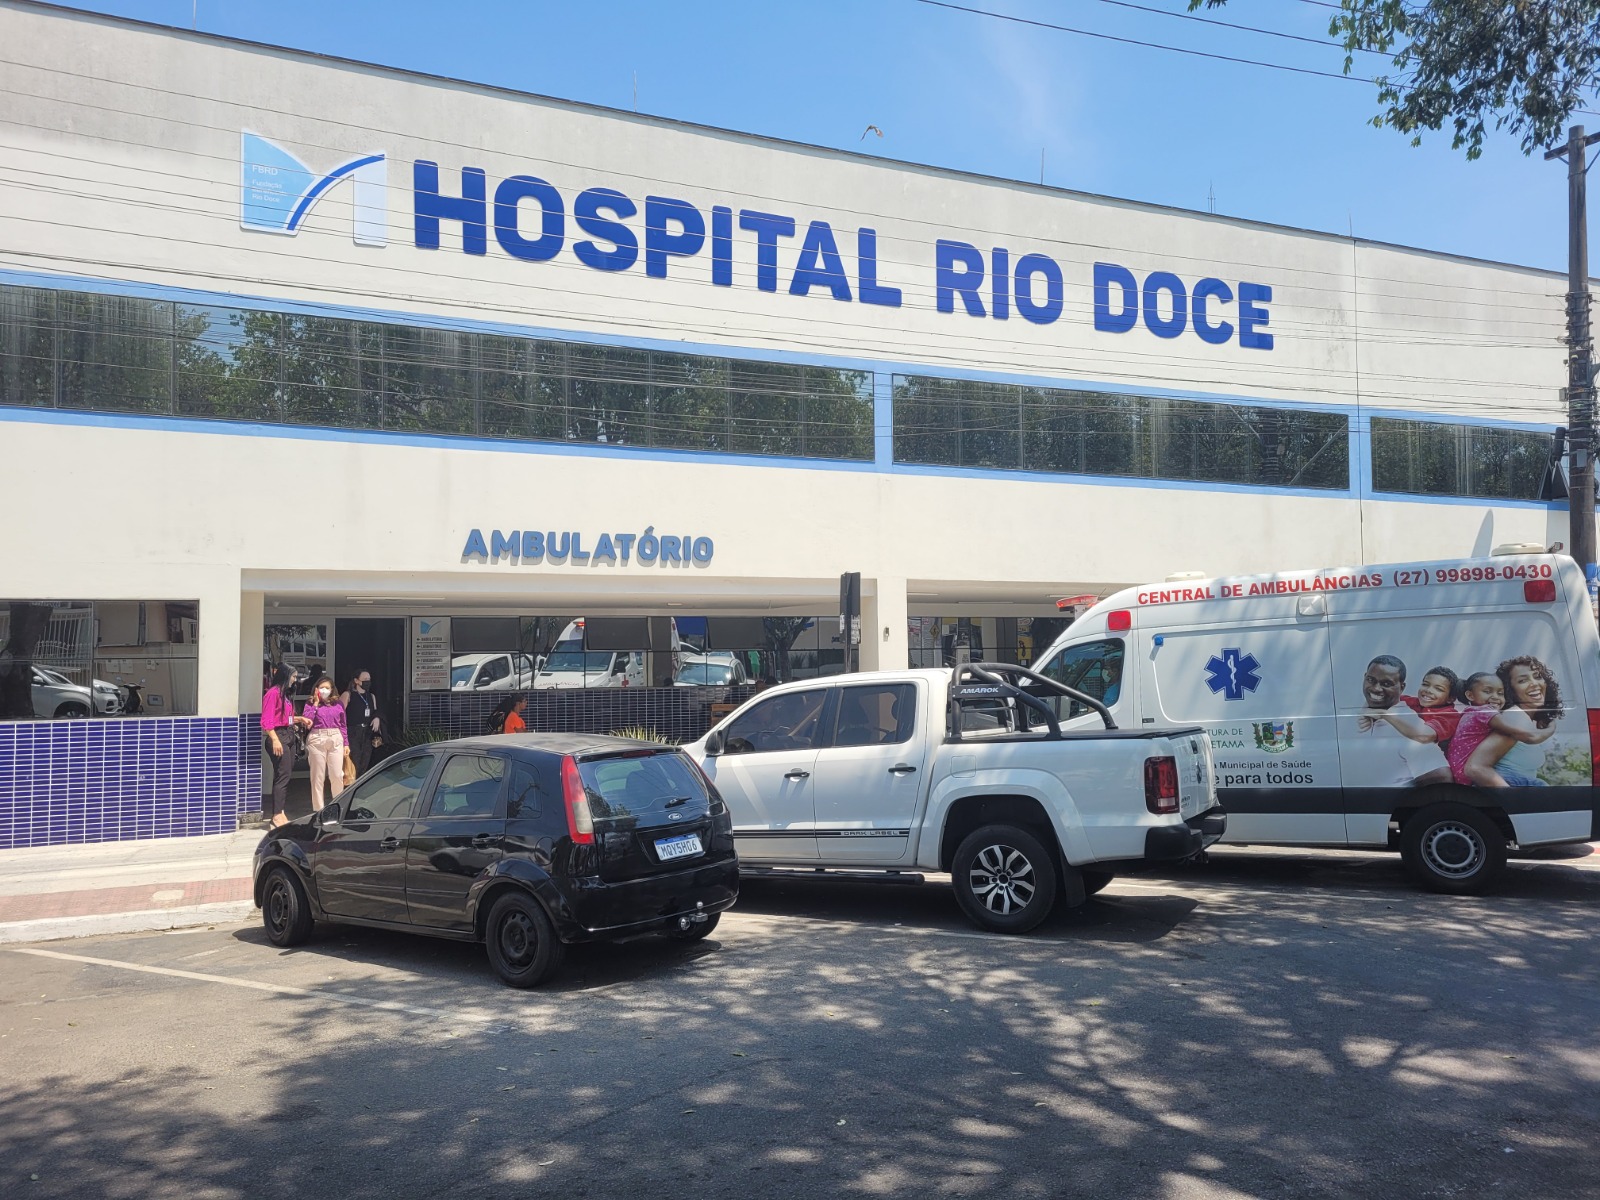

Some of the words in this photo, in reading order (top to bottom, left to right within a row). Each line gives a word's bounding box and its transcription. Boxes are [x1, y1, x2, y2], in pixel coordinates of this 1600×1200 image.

[252, 164, 278, 176] FBRD
[413, 159, 902, 308] HOSPITAL
[936, 238, 1064, 325] RIO
[1093, 261, 1274, 351] DOCE
[461, 525, 715, 563] AMBULATÓRIO
[1138, 586, 1215, 605] CENTRAL
[1220, 584, 1243, 598] DE
[1248, 573, 1383, 596] AMBULÂNCIAS
[1393, 568, 1430, 587] (27)
[1435, 564, 1553, 583] 99898-0430
[1231, 728, 1244, 736] DE
[1219, 761, 1264, 771] Municipal
[1266, 760, 1279, 768] de
[1281, 760, 1312, 769] Saúde
[1225, 773, 1261, 787] para
[1266, 771, 1314, 784] todos
[660, 840, 698, 858] MQY5H06
